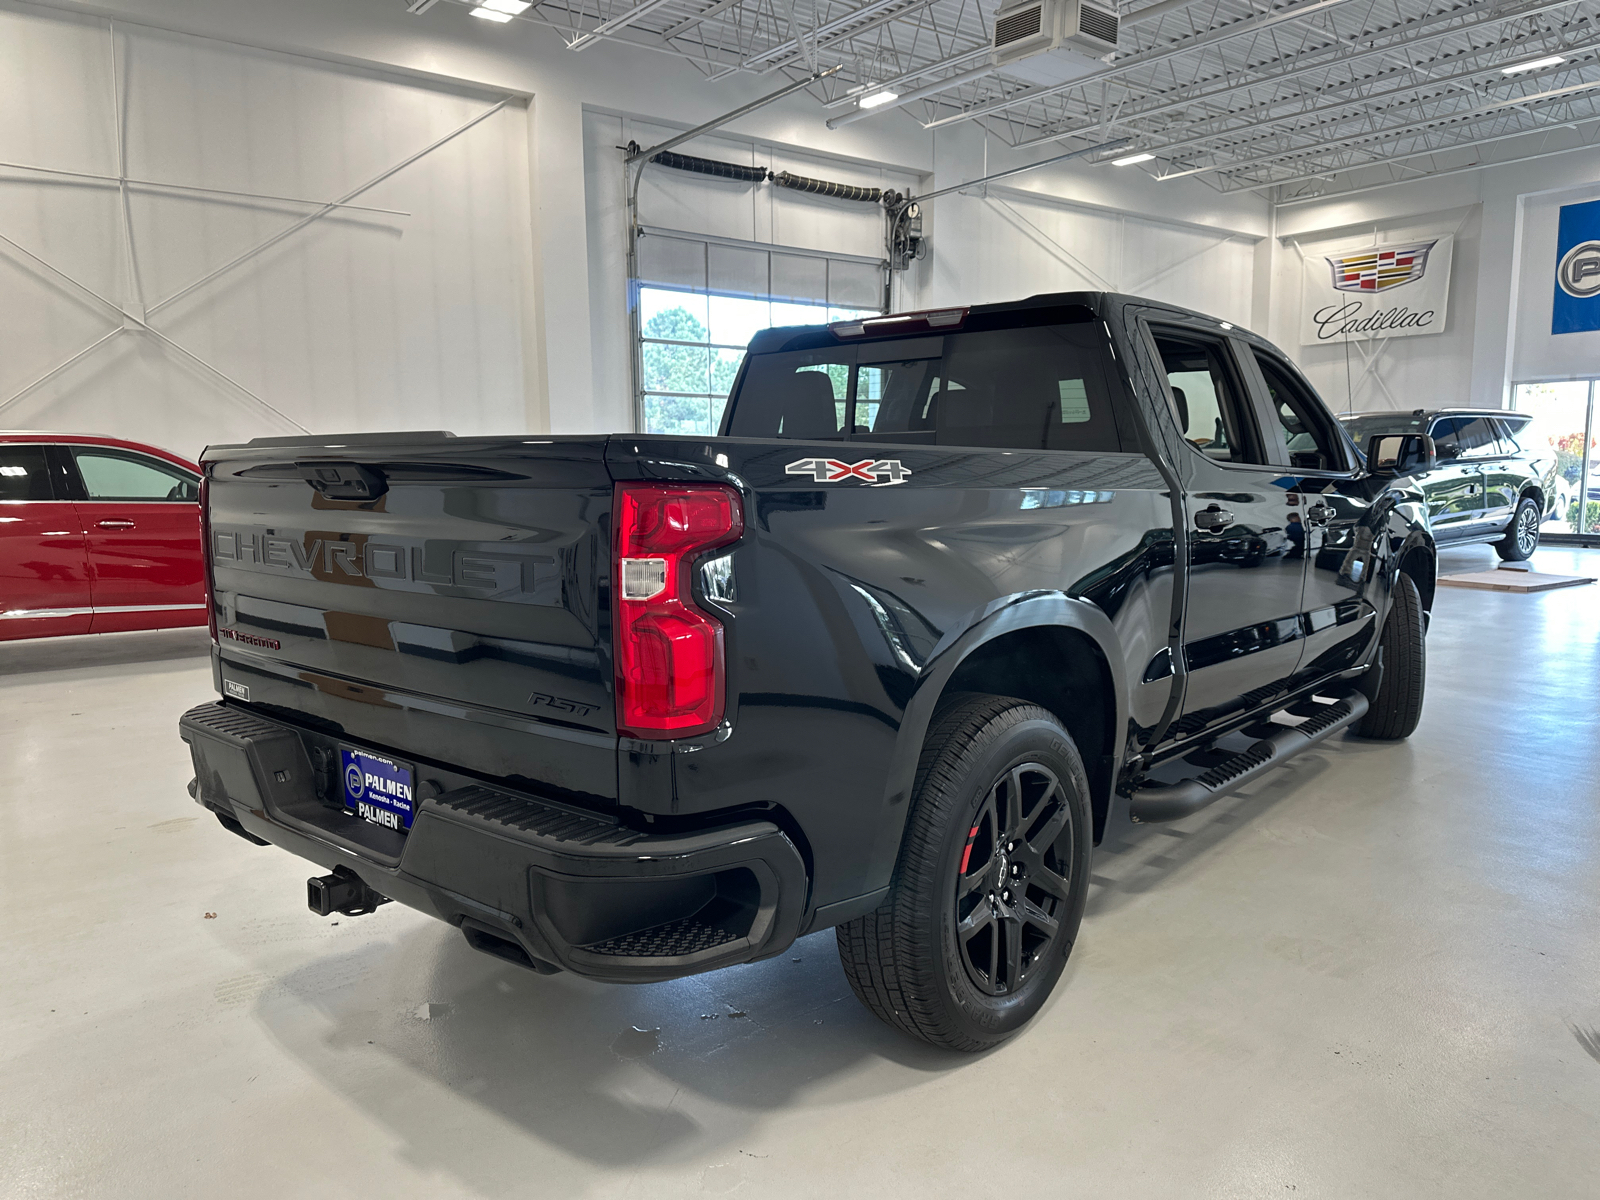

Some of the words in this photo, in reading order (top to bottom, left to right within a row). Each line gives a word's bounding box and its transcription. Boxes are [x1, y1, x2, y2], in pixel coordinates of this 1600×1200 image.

[1313, 301, 1435, 340] Cadillac
[213, 530, 556, 594] CHEVROLET
[228, 682, 245, 695] PALMEN
[527, 691, 601, 717] RST
[354, 750, 393, 765] palmen.com
[365, 773, 412, 801] PALMEN
[368, 791, 390, 805] Kenosha
[393, 799, 411, 812] Racine
[358, 802, 398, 829] PALMEN
